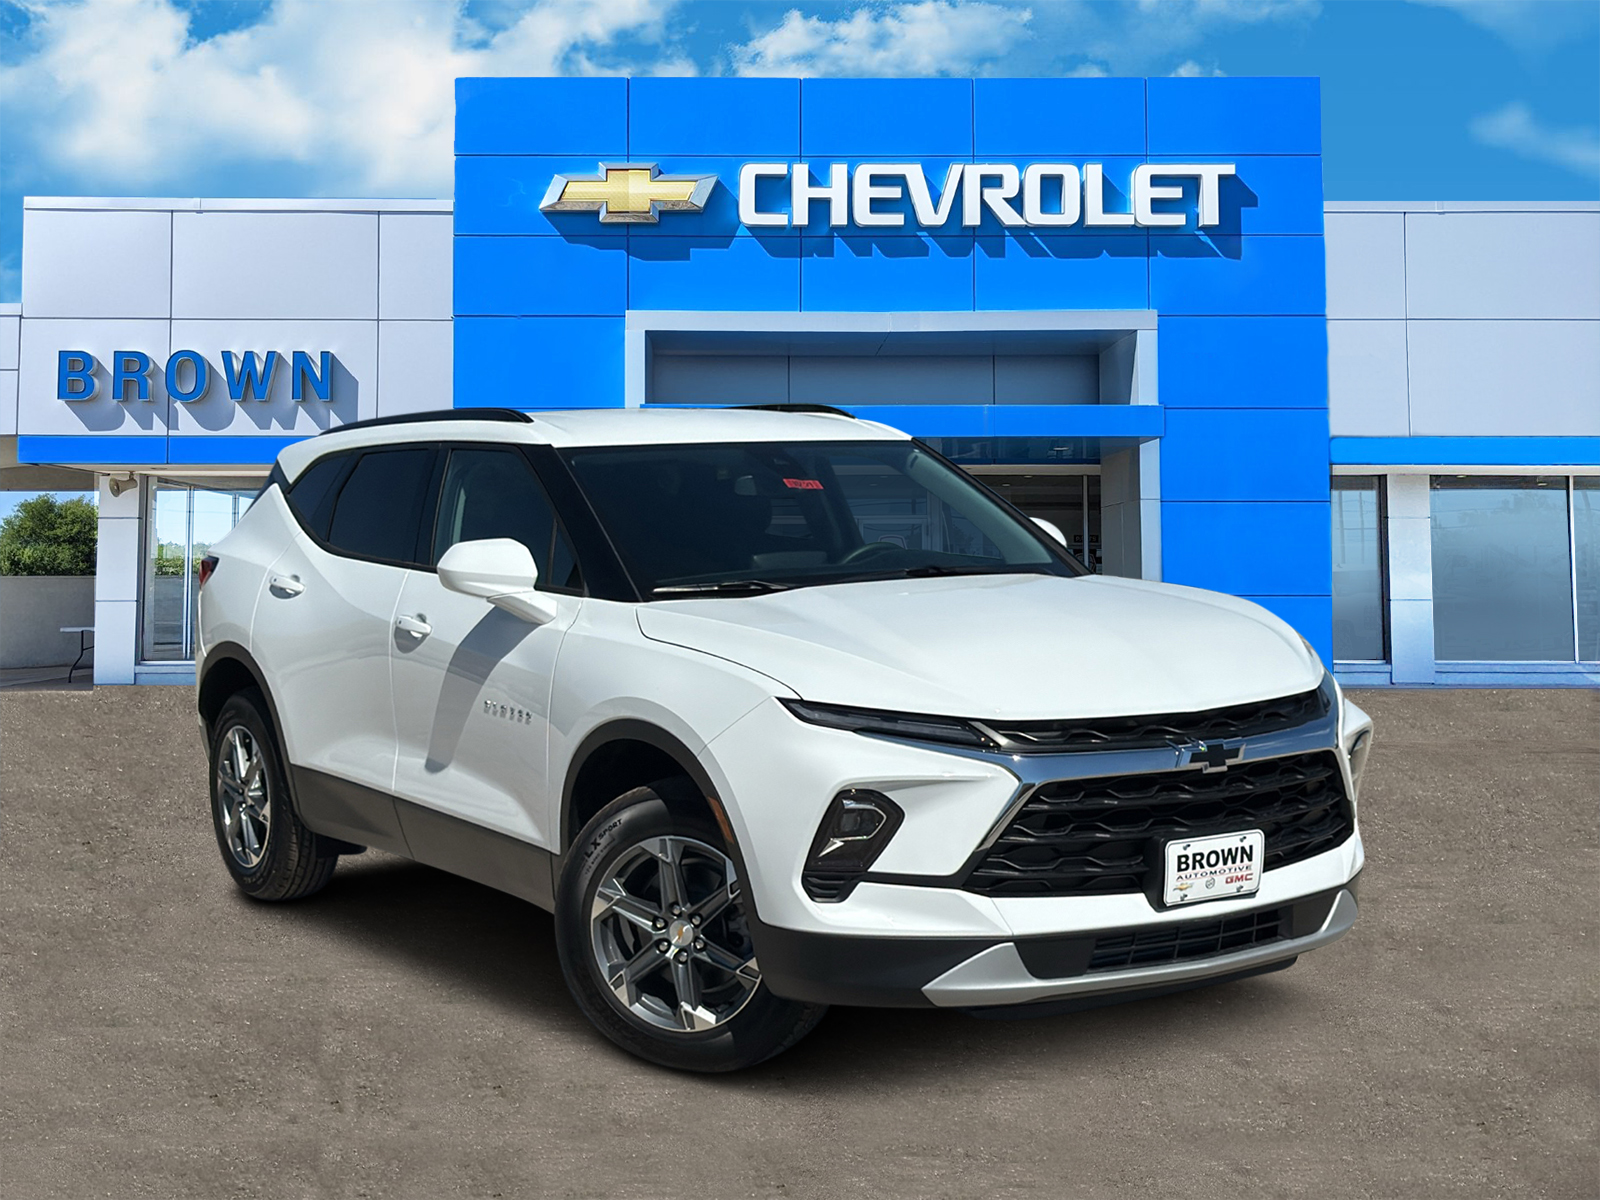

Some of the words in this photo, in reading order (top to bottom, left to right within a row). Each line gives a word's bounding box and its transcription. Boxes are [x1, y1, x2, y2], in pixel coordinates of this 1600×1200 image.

[737, 162, 1237, 228] CHEVROLET
[57, 350, 332, 402] BROWN
[584, 837, 601, 859] LX
[598, 818, 623, 840] SPORT
[1176, 865, 1253, 881] AUTOMOTIVE
[1177, 845, 1254, 872] BROWN
[1225, 873, 1254, 885] GMC
